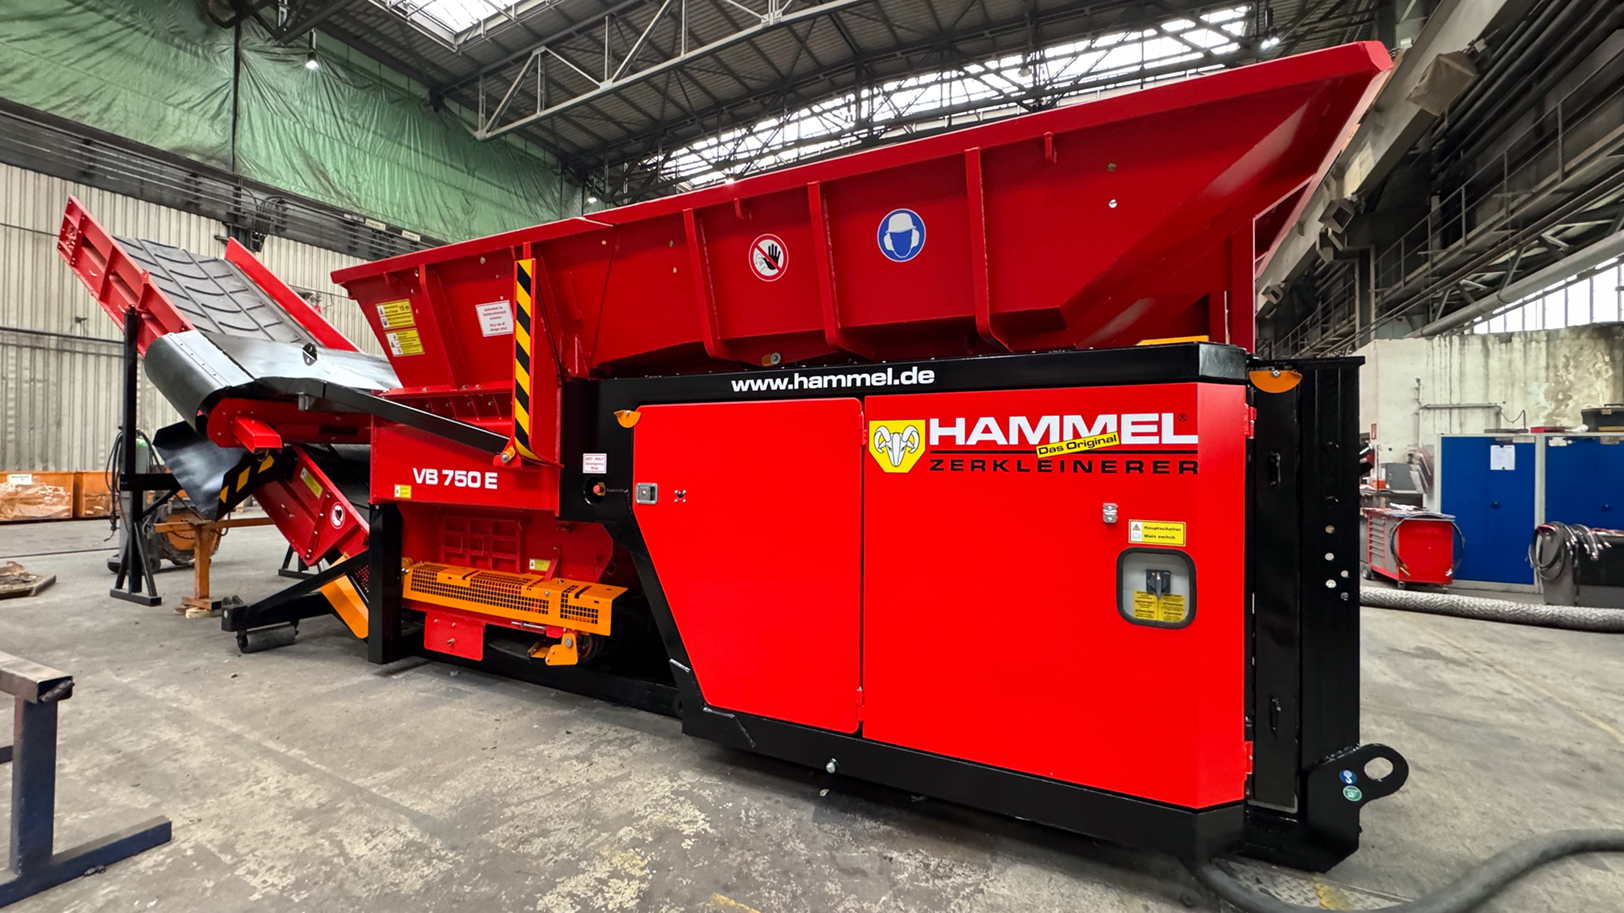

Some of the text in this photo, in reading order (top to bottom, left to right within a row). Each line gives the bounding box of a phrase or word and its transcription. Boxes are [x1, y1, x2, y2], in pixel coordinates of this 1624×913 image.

[731, 366, 936, 392] www.hammel.de
[1038, 434, 1118, 456] Das Original
[929, 459, 1198, 475] ZERKLEINERER
[412, 468, 498, 490] VB 750 E
